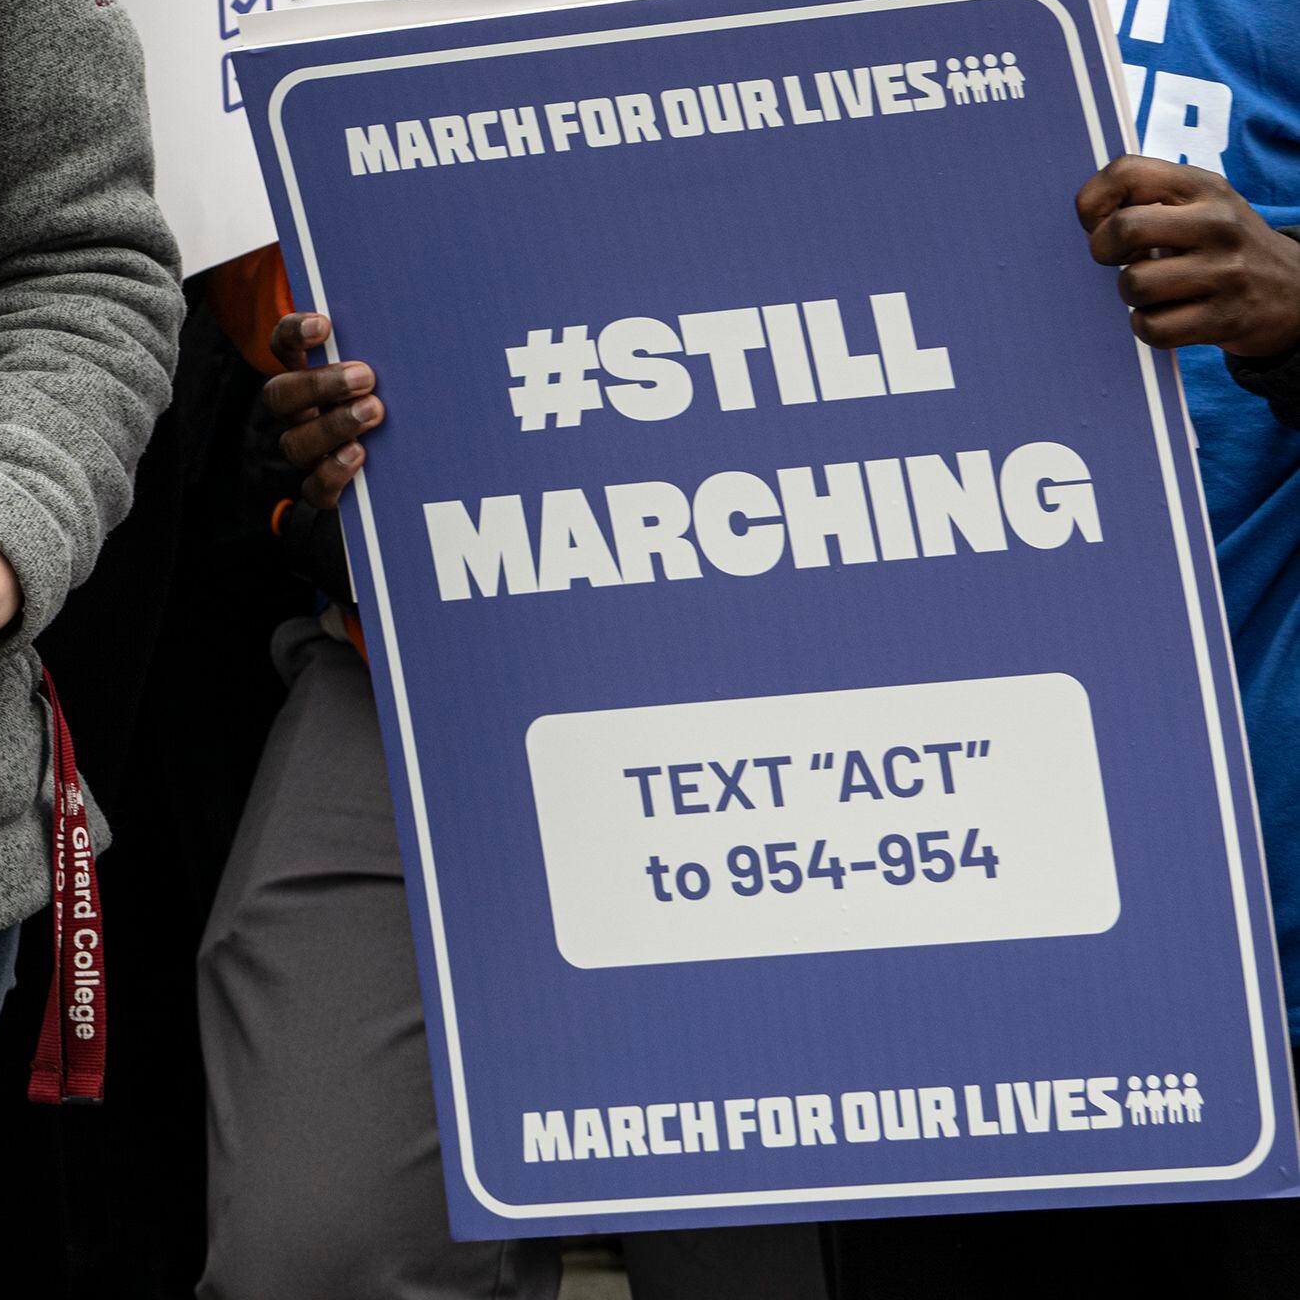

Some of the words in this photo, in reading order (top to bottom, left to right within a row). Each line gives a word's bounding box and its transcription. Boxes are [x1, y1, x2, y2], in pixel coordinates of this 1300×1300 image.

[344, 105, 546, 177] MARCH
[544, 92, 662, 153] FOR
[659, 78, 785, 139] OUR
[788, 59, 948, 126] LIVES
[504, 291, 956, 432] #STILL
[422, 441, 1104, 604] MARCHING
[622, 753, 794, 820] TEXT
[71, 825, 98, 920] Girard
[644, 852, 712, 904] to
[725, 826, 1000, 899] 954-954
[68, 927, 101, 1041] College
[522, 1099, 720, 1164] MARCH
[724, 1093, 838, 1151] FOR
[840, 1086, 962, 1144] OUR
[963, 1075, 1124, 1136] LIVES
